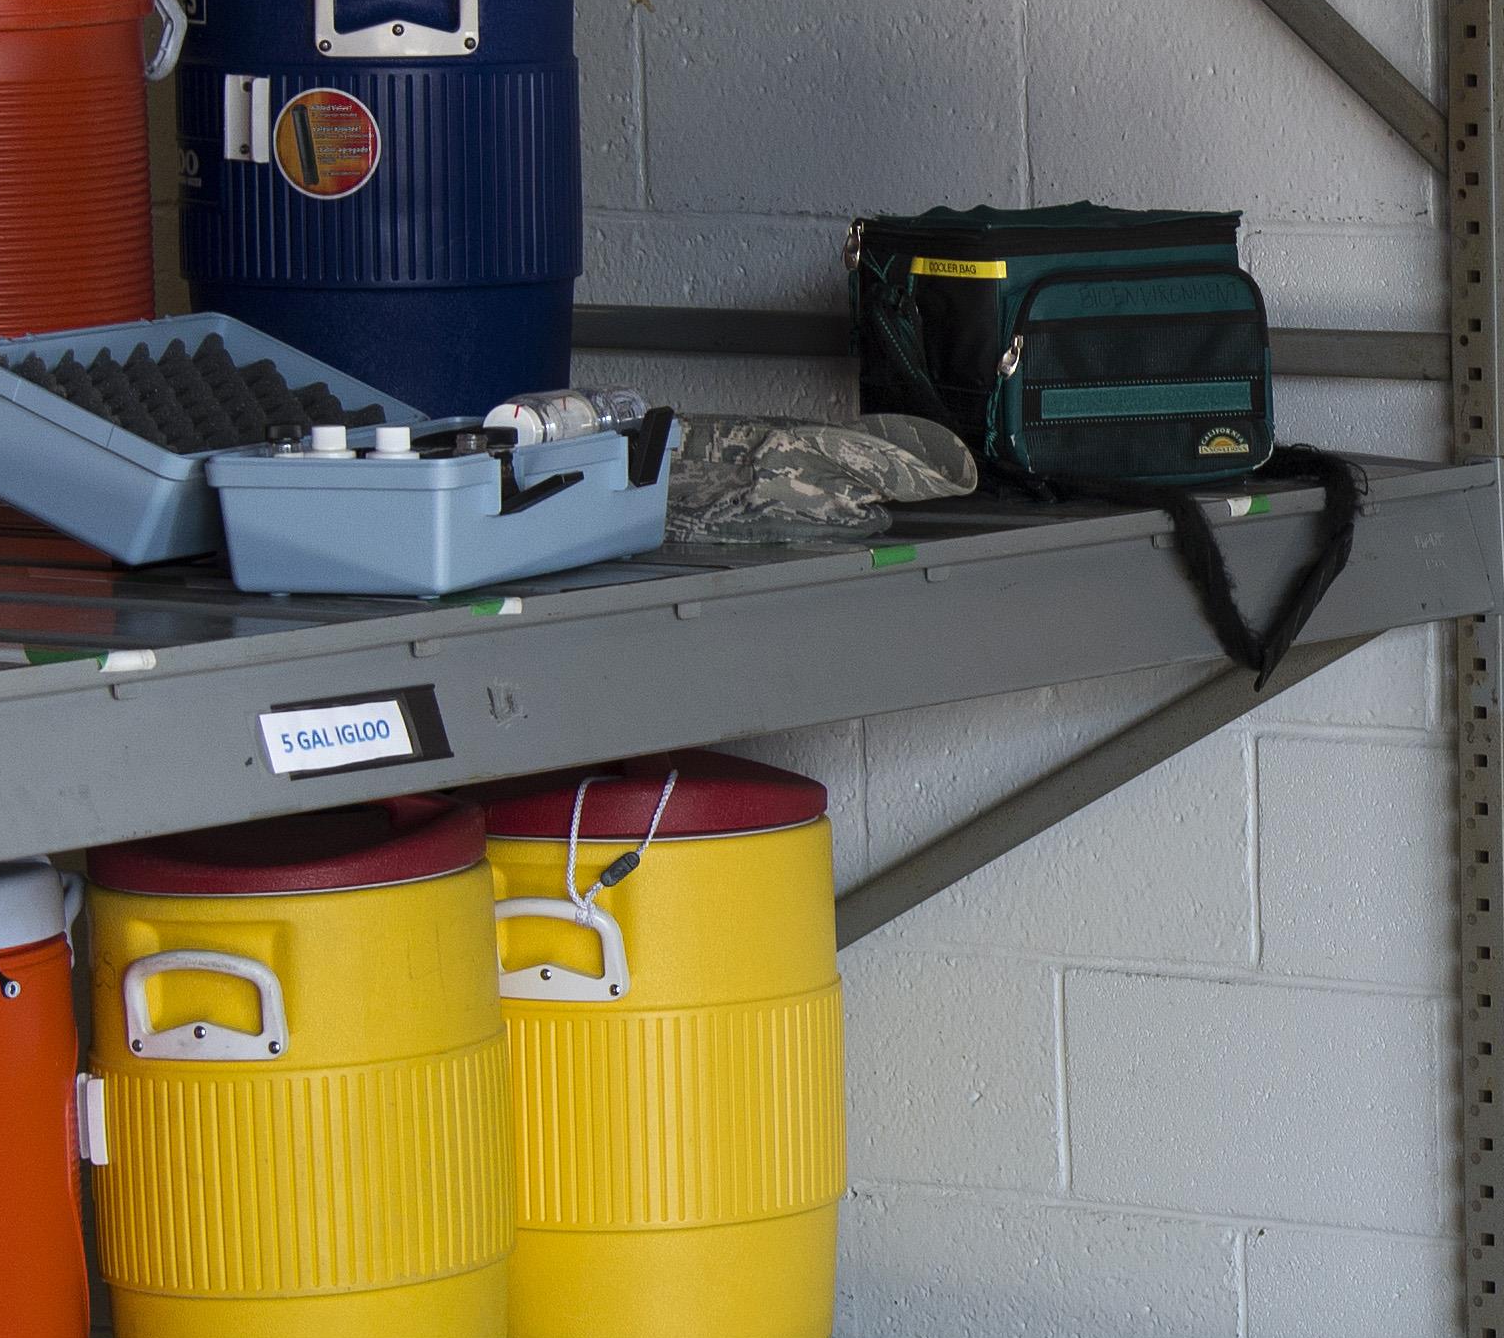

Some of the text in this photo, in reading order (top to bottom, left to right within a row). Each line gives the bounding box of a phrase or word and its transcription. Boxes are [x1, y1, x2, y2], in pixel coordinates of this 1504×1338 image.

[928, 261, 977, 275] COOLER BAG
[280, 719, 391, 754] 5 GAL IGLOO
